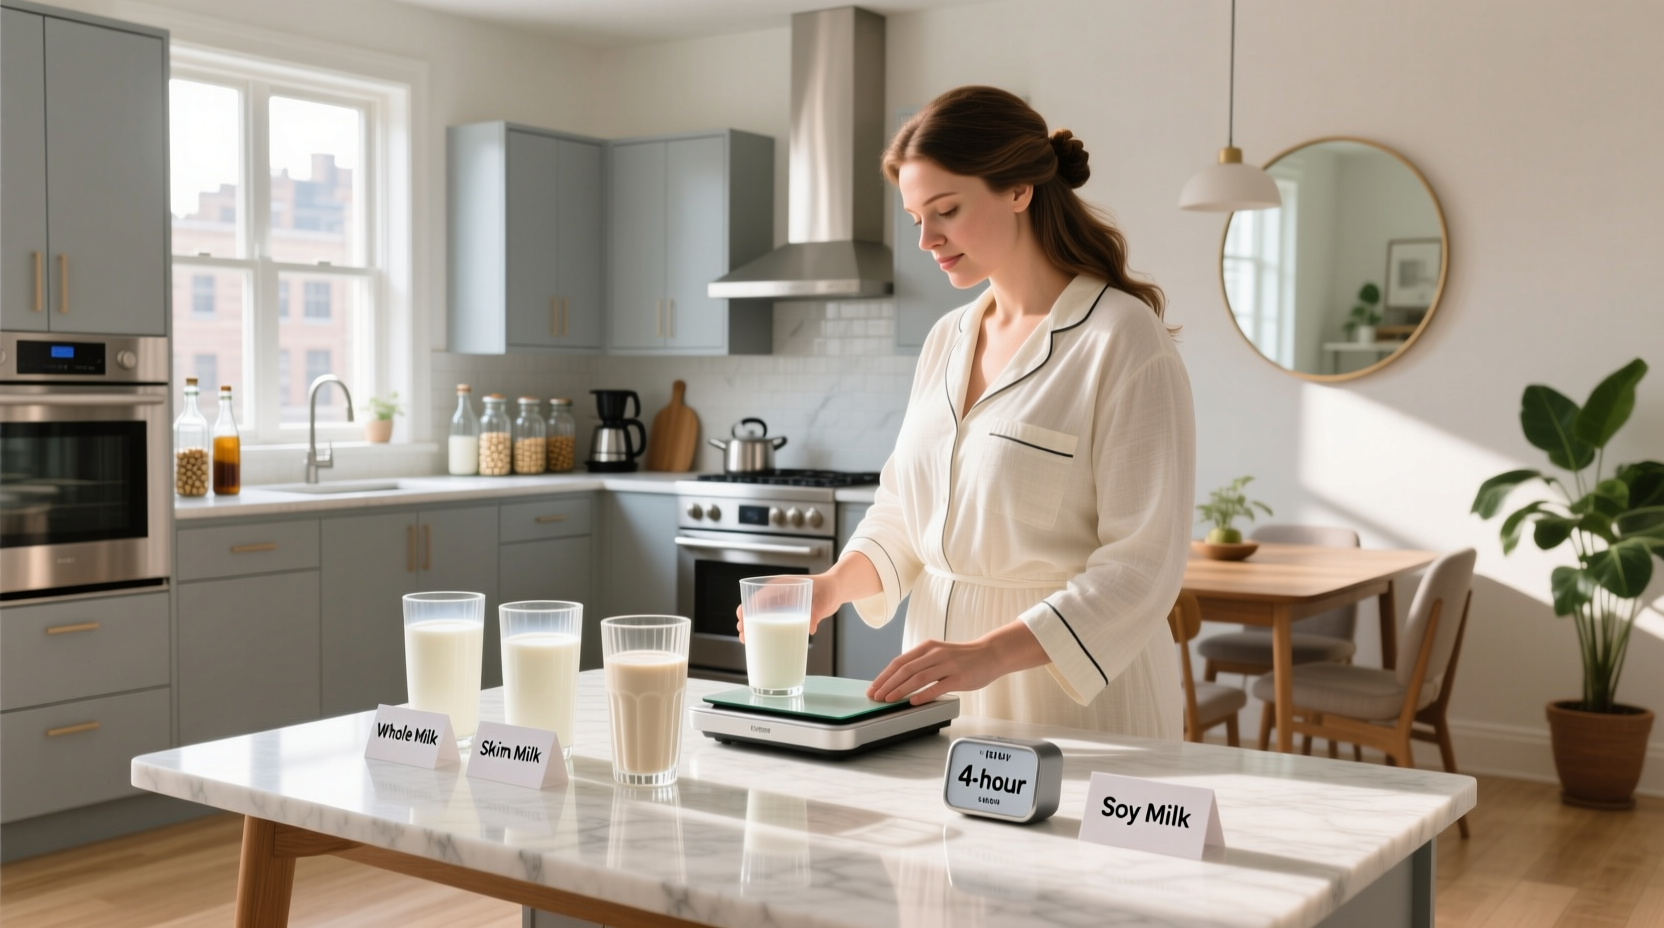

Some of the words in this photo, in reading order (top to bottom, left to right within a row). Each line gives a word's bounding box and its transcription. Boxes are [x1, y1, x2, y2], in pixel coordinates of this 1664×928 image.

[377, 722, 413, 742] Whole
[414, 727, 439, 746] Milk
[513, 745, 542, 764] Milk
[957, 764, 1027, 795] 4-hour
[1101, 796, 1142, 826] Soy
[1145, 802, 1192, 829] Milk
